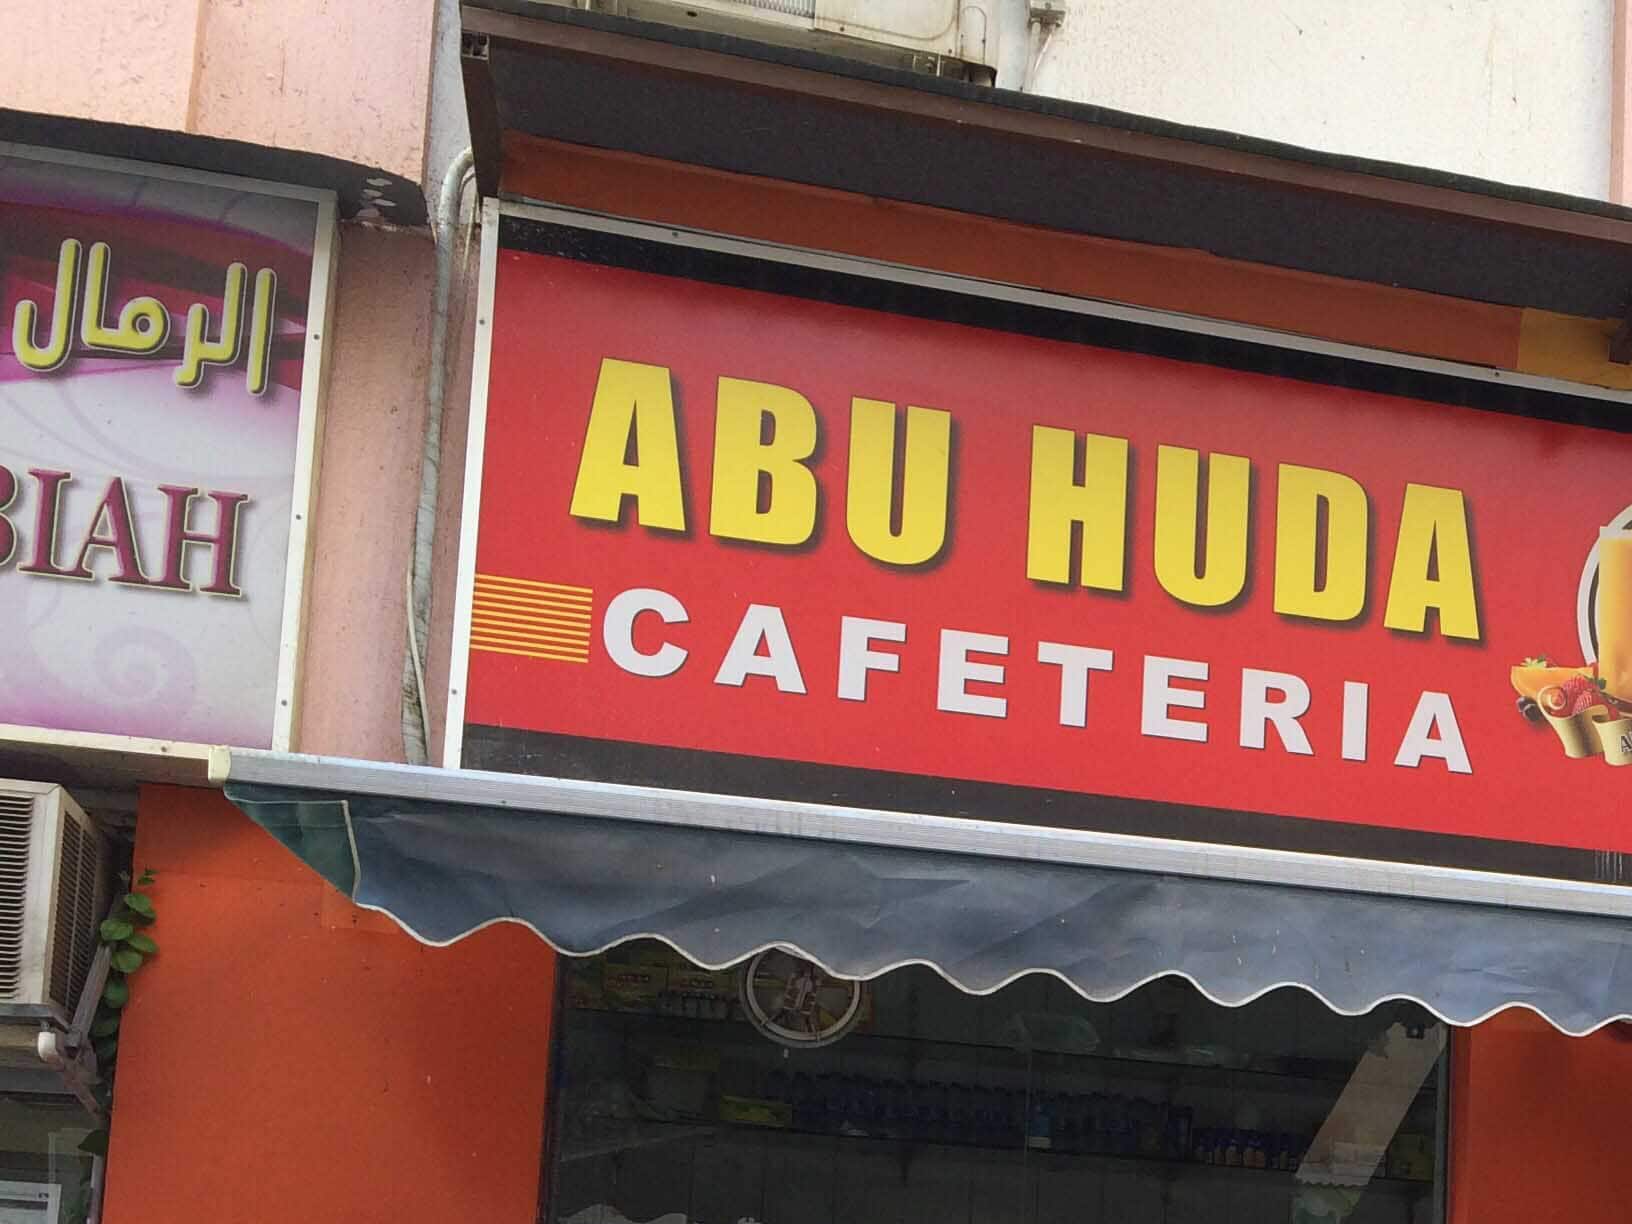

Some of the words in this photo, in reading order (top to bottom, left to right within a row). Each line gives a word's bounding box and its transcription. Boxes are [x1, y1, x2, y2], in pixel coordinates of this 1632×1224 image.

[12, 236, 278, 396] الرمال
[569, 357, 953, 566] ABU
[1026, 423, 1481, 641] HUDA
[602, 587, 1474, 775] CAFETERIA
